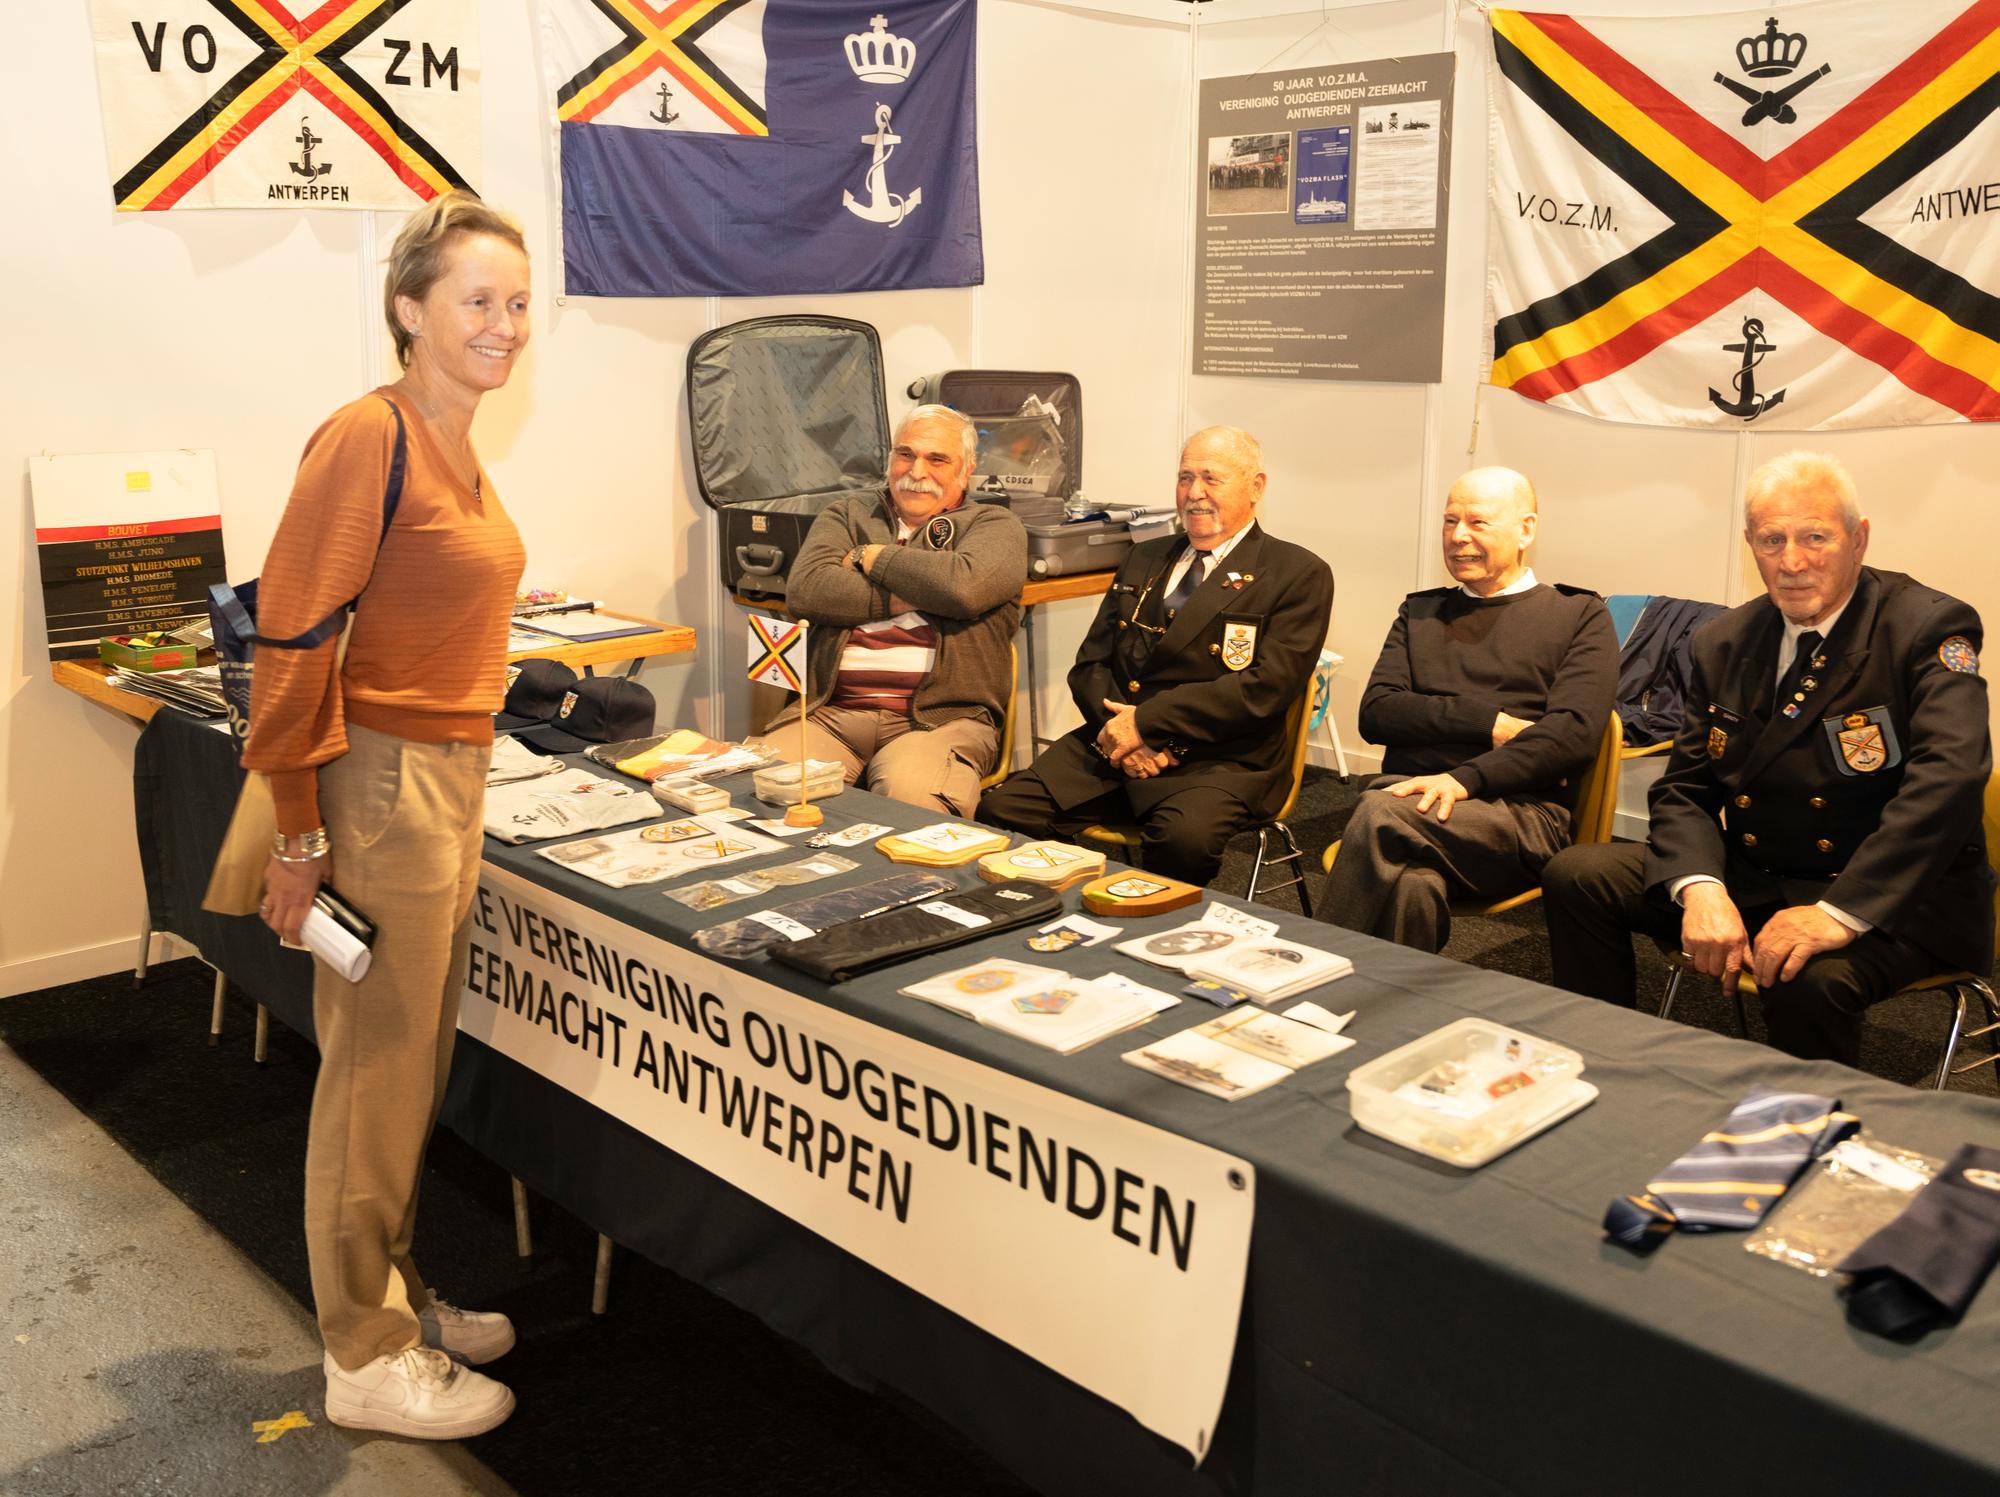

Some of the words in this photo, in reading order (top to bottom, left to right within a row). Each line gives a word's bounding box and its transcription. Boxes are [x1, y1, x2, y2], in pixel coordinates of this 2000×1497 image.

[1273, 80, 1284, 92] 50
[1285, 77, 1313, 91] JAAR
[1319, 72, 1368, 87] V.O.Z.M.A.
[1219, 95, 1279, 112] VERENIGING
[1284, 88, 1366, 105] OUDGEDIENDEN
[1367, 80, 1428, 98] ZEEMACHT
[1286, 104, 1351, 120] ANTWERPEN
[268, 184, 349, 202] ANTWERPEN
[1517, 191, 1618, 232] V.O.Z.M.
[1910, 183, 2000, 224] ANTWE
[108, 524, 149, 536] BOUVET
[95, 540, 120, 550] H.M.S.
[121, 536, 176, 548] AMBUSCADE
[108, 550, 135, 560] H.M.S.
[138, 548, 164, 558] JUNO
[76, 564, 130, 577] STUTZPUNKT
[132, 557, 202, 572] WILHELMSHAVEN
[134, 571, 174, 582] DIOMEDE
[131, 582, 177, 594] PENELOPE
[135, 607, 184, 618] LIVERPOOL
[463, 942, 627, 1068] EEMACHT
[633, 1029, 912, 1224] ANTWERPEN
[498, 895, 732, 1048] VERENIGING
[742, 1010, 1196, 1273] OUDGEDIENDEN
